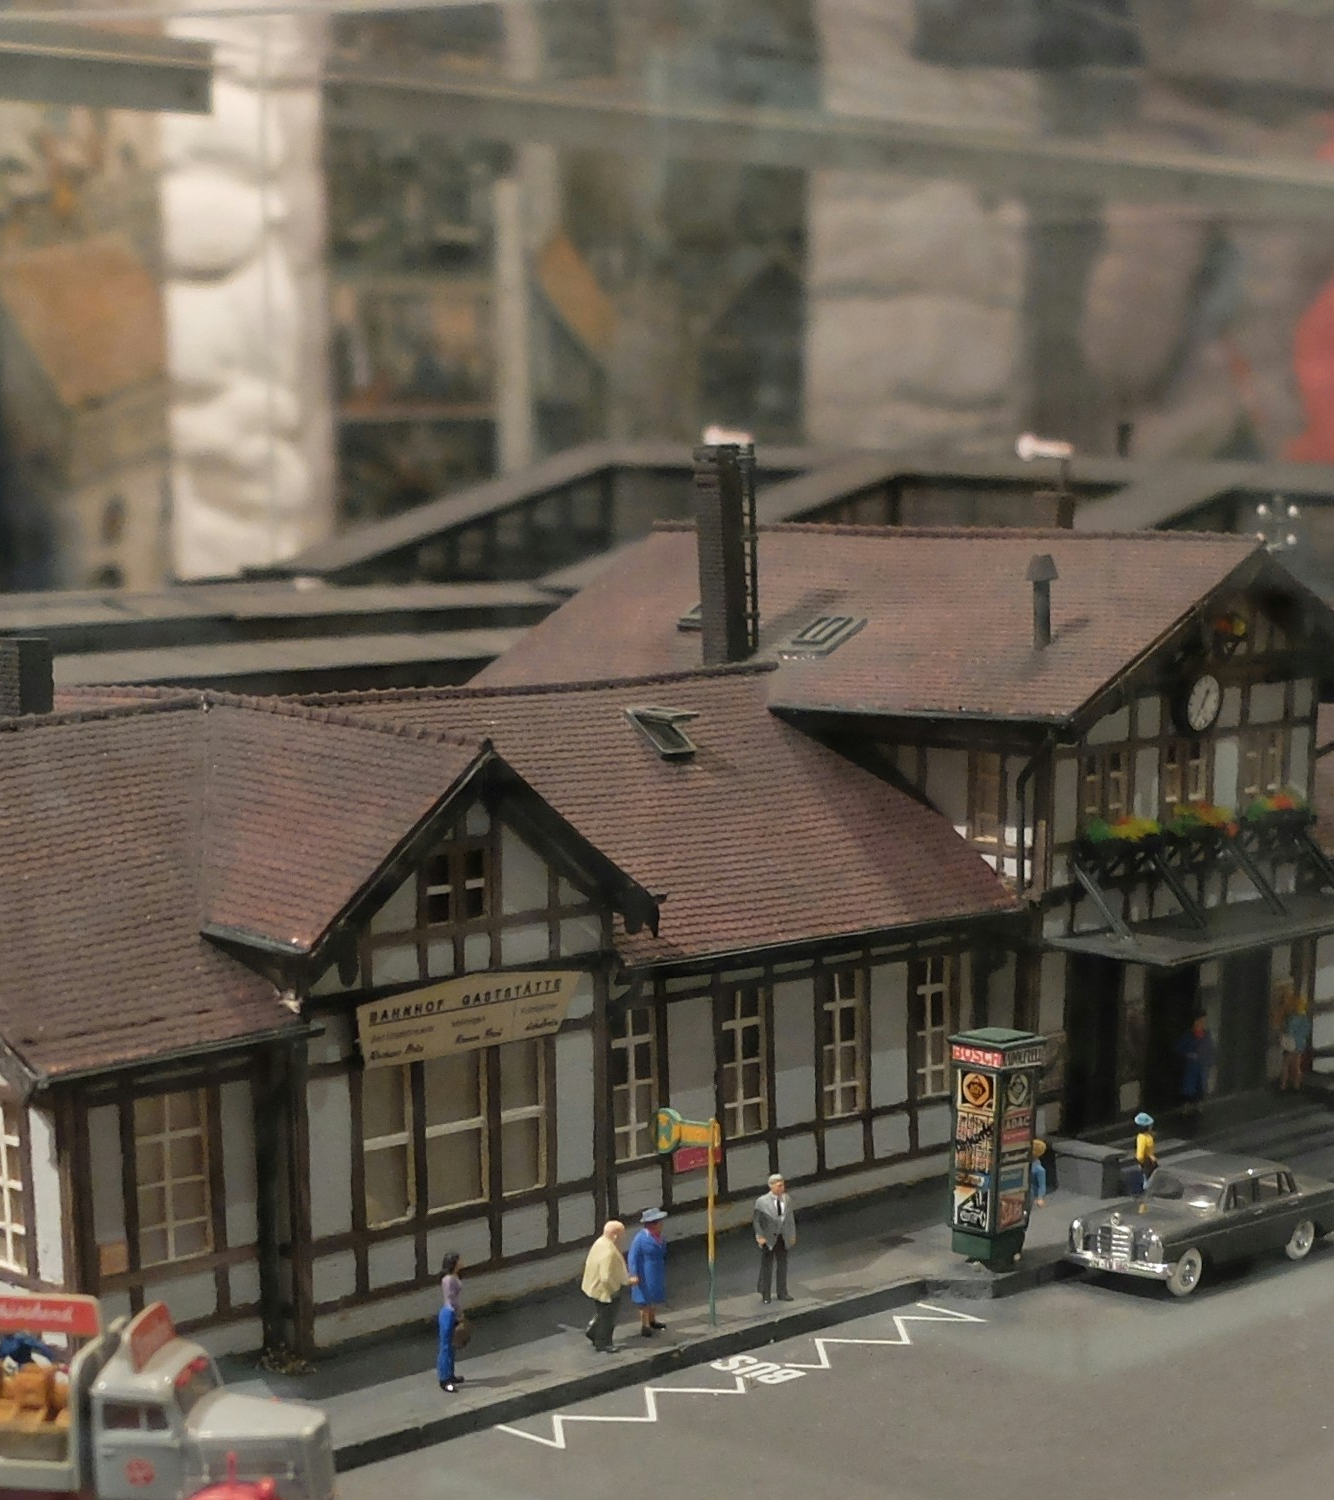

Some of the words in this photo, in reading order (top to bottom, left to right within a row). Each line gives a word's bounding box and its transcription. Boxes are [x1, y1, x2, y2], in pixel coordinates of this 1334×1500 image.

[369, 999, 443, 1024] BAHNHOF
[953, 1045, 1004, 1068] BOSCH
[1004, 1116, 1030, 1130] ADAC
[710, 1355, 807, 1385] BUS
